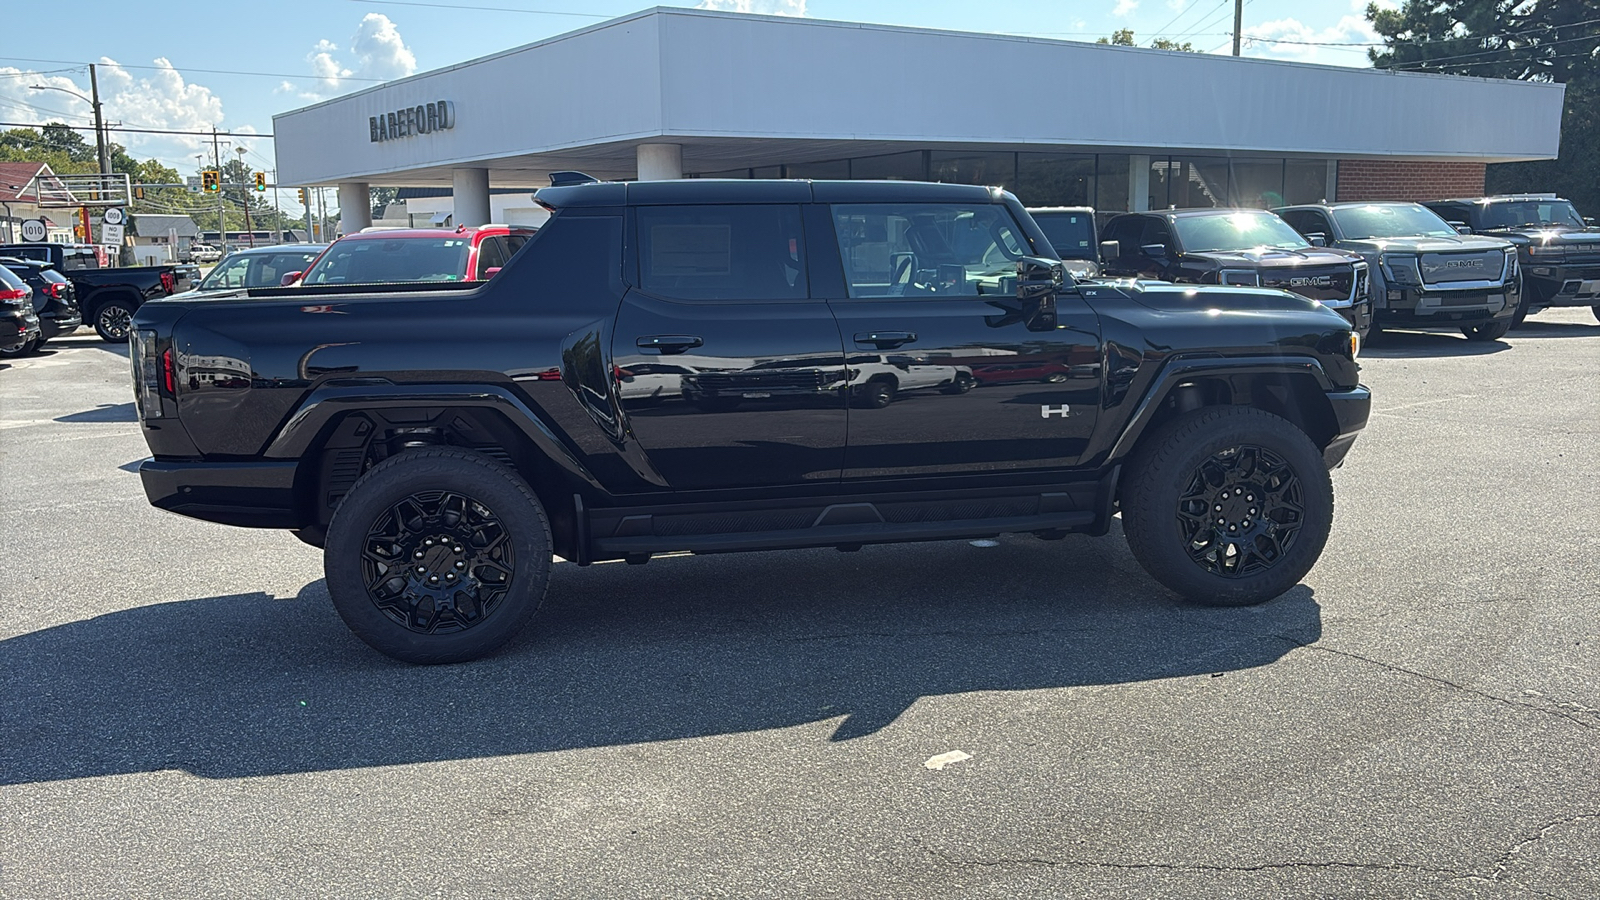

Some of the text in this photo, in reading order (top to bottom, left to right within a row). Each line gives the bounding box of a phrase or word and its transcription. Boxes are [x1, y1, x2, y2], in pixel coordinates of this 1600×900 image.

[369, 100, 455, 143] BAREFORD
[25, 226, 43, 235] 1010
[1446, 259, 1483, 268] GMC
[1290, 276, 1330, 286] GMC
